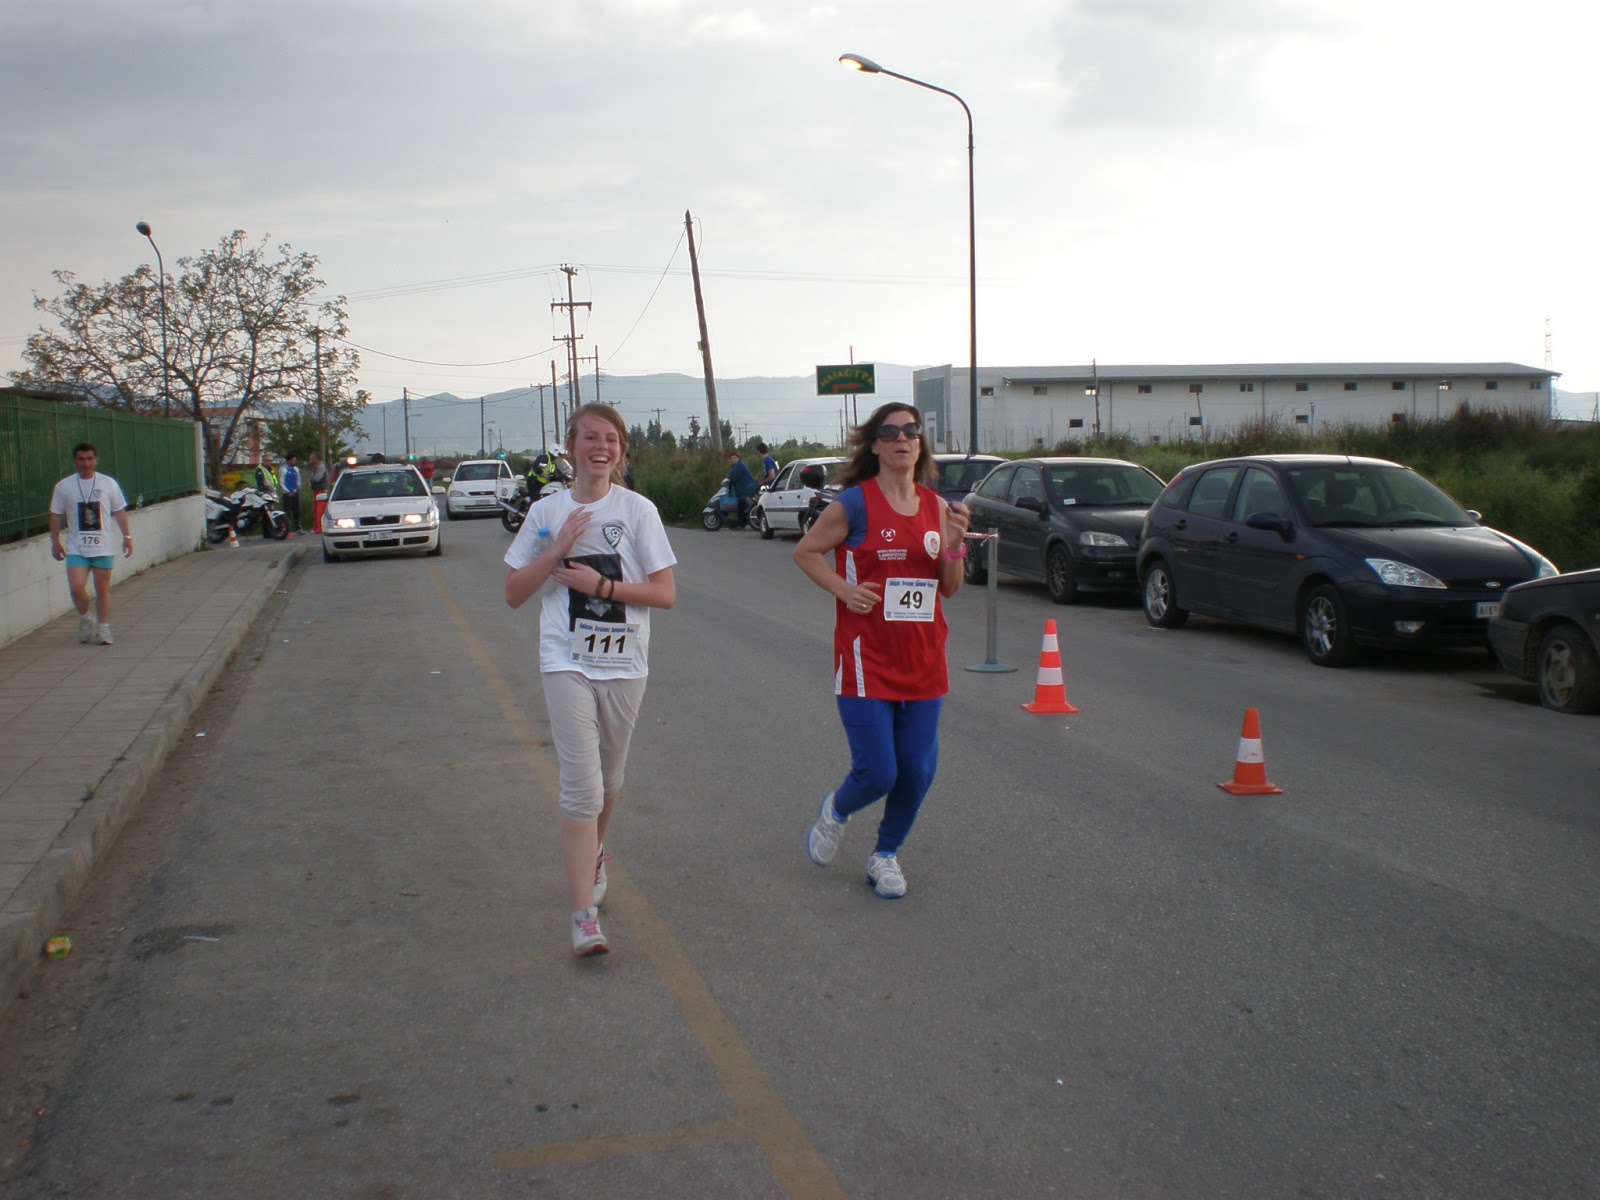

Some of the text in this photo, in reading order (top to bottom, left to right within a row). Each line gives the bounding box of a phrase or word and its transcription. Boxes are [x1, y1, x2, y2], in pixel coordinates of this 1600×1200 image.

[82, 536, 100, 544] 176
[899, 590, 923, 609] 49
[584, 633, 626, 654] 111
